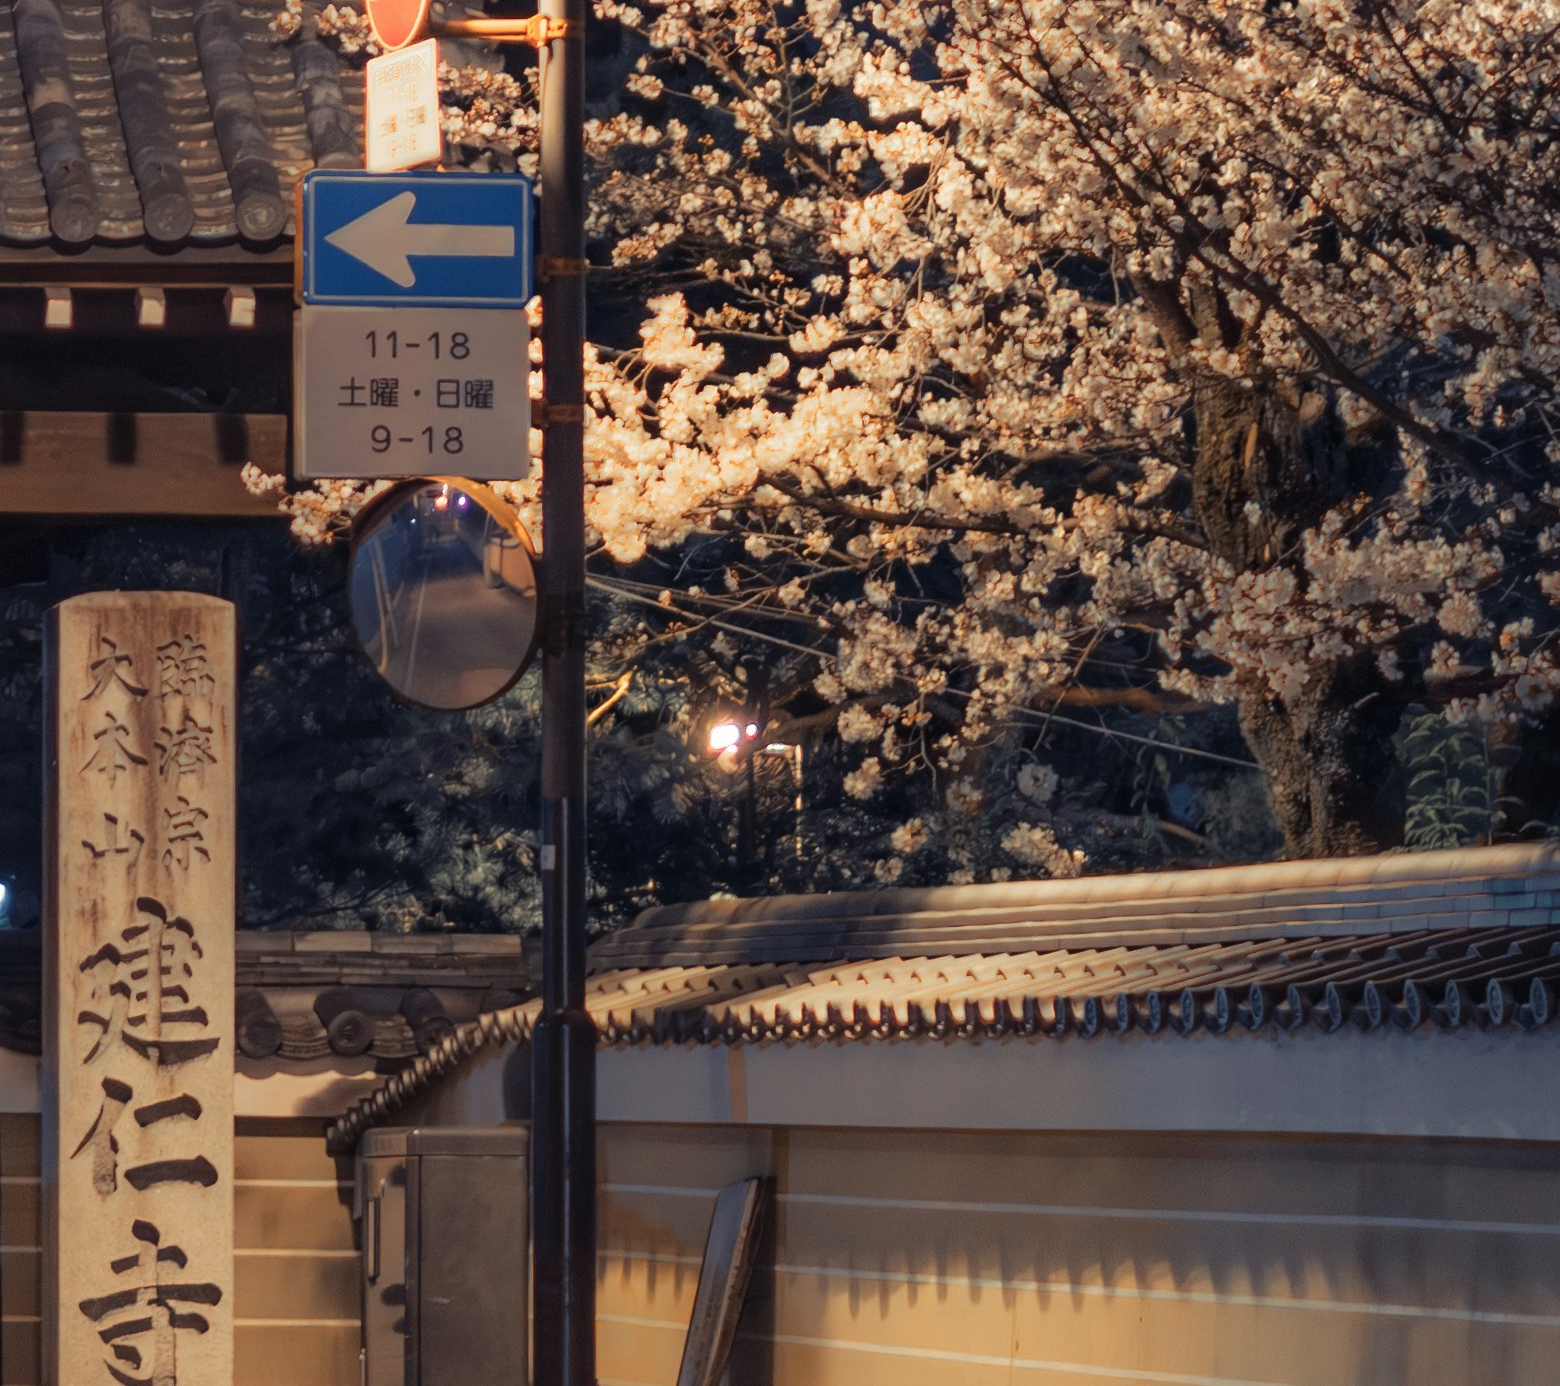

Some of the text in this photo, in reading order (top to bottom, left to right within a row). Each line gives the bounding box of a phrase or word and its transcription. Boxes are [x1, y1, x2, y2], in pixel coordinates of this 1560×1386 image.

[365, 330, 470, 360] 11-18
[337, 376, 494, 409] 土曜・日曜
[371, 424, 464, 454] 9-18
[81, 635, 146, 873] 大本山
